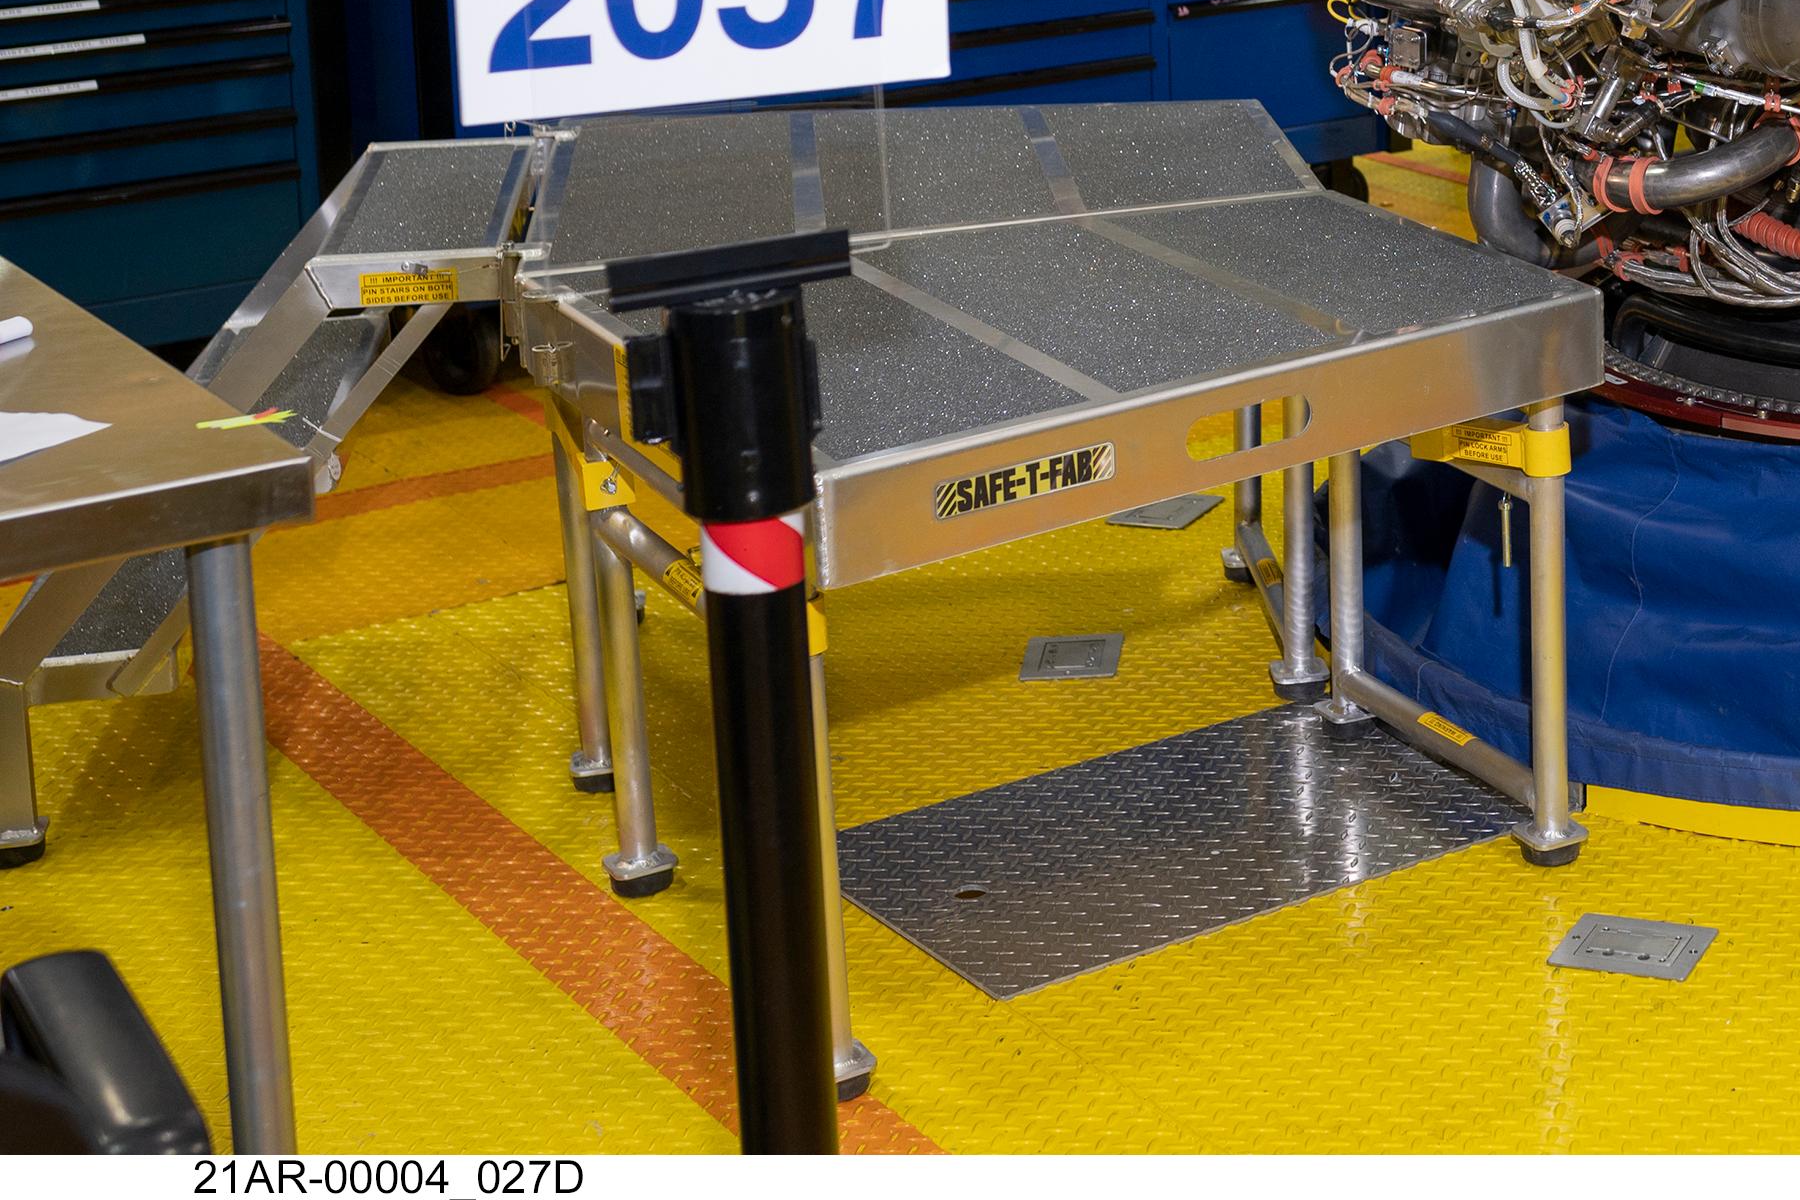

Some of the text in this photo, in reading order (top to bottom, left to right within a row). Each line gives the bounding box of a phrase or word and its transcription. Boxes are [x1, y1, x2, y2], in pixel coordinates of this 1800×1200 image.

[382, 274, 434, 284] IMPORTANT
[363, 288, 377, 296] PIN
[380, 286, 411, 295] STAIRS
[366, 296, 392, 304] SIDES
[394, 294, 428, 303] BEFORE
[1464, 429, 1501, 441] IMPORTANT
[1460, 440, 1507, 454] PIN LOCK ARMS
[1464, 449, 1503, 462] BEFORE USE
[957, 449, 1093, 513] SAFE-T-FAB
